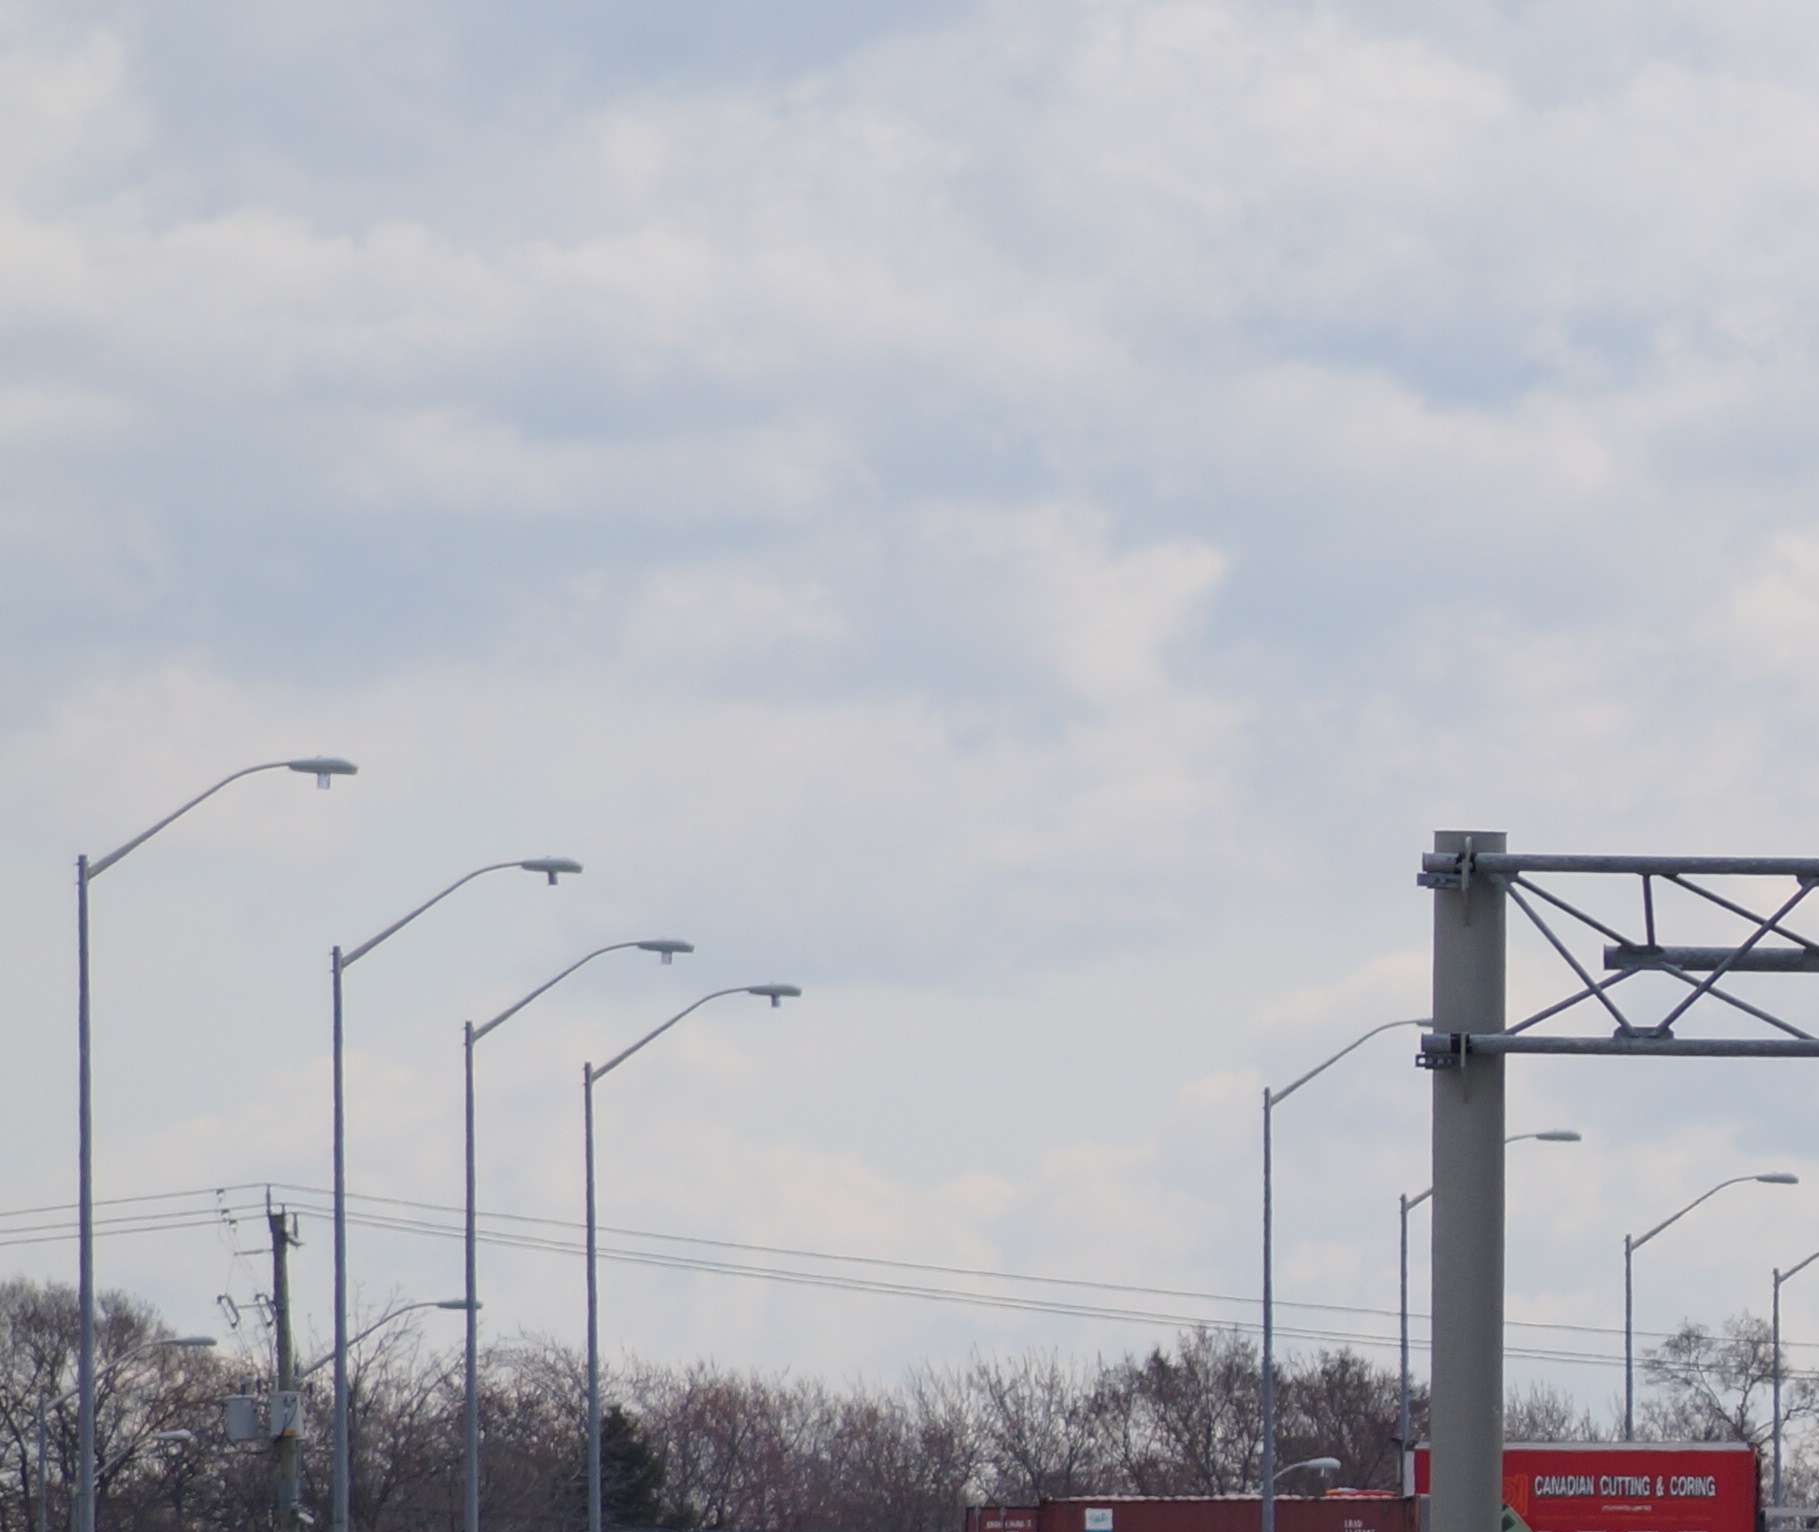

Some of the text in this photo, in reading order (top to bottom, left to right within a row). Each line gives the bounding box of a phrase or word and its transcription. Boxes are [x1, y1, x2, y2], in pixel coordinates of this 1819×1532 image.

[1534, 1475, 1716, 1497] CANADIAN CUTTING & CORING
